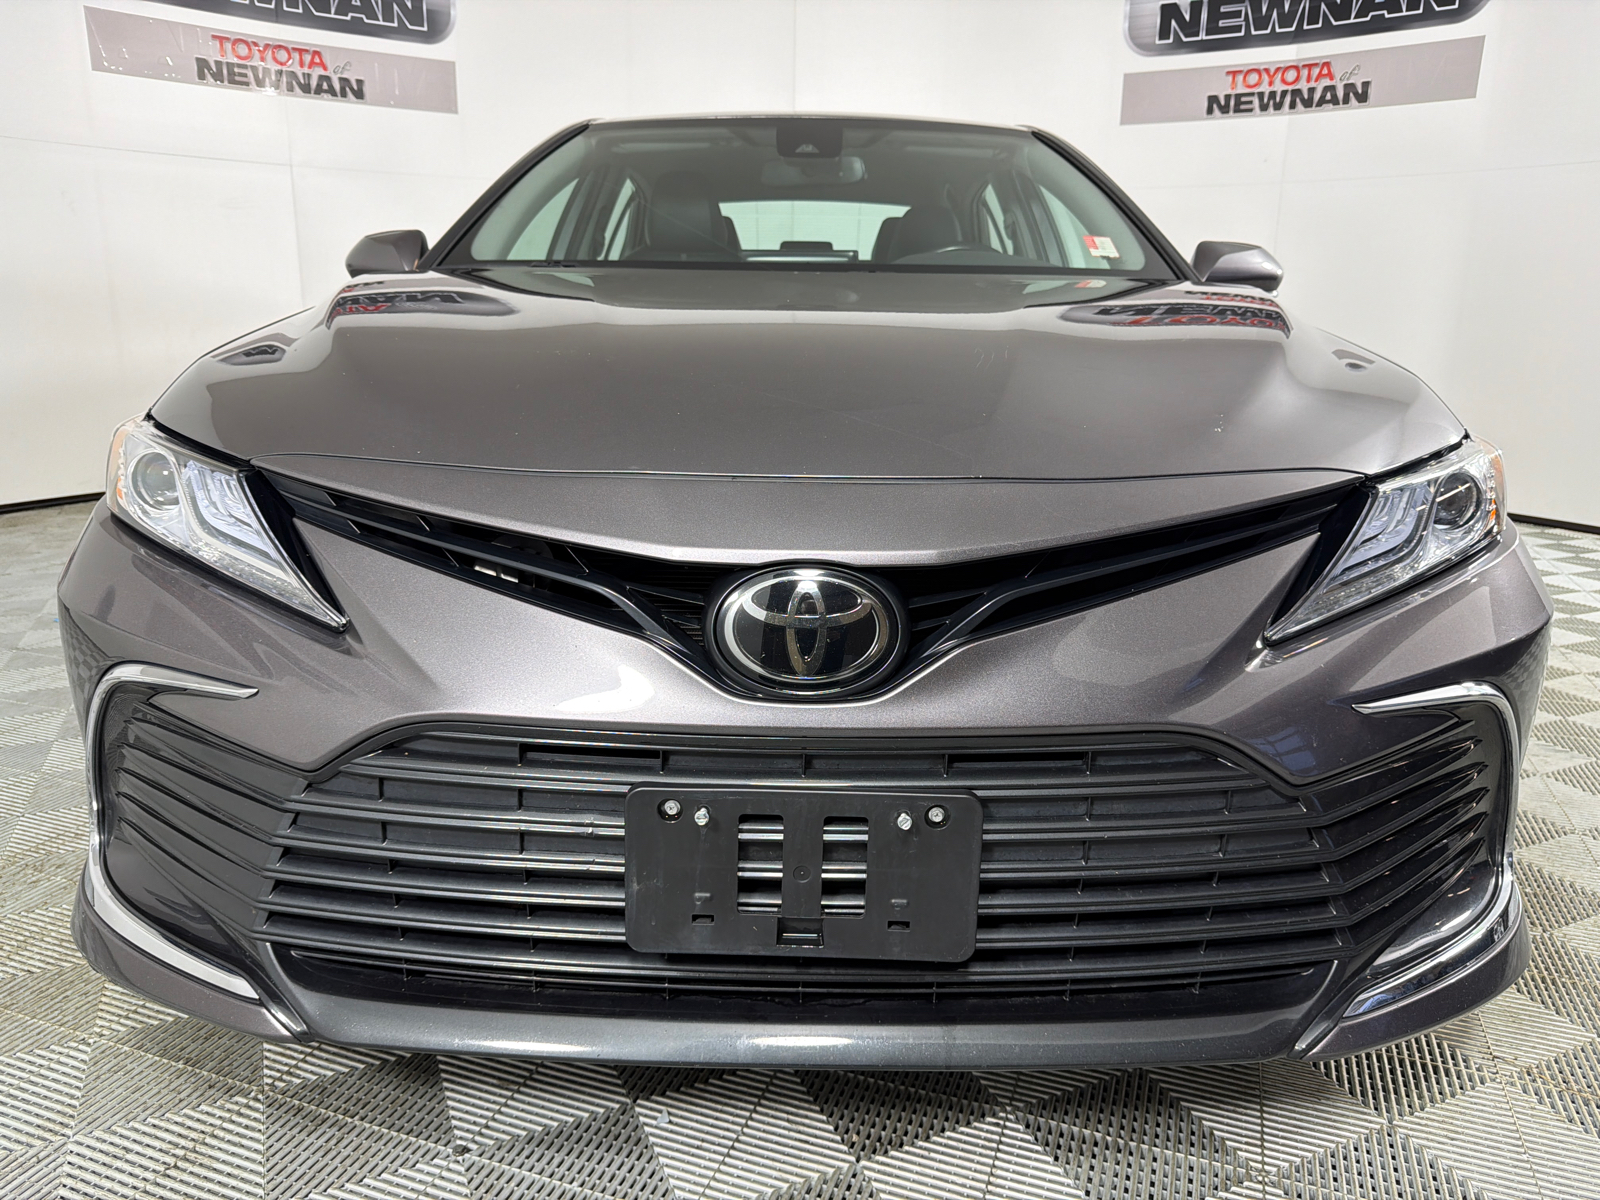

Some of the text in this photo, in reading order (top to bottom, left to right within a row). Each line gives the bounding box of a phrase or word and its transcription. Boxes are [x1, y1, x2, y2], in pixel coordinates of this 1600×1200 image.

[211, 34, 352, 76] TOYOTA of
[195, 56, 365, 100] NEWNAN
[1226, 61, 1361, 91] TOYOTA of
[1206, 80, 1372, 116] NEWNAN
